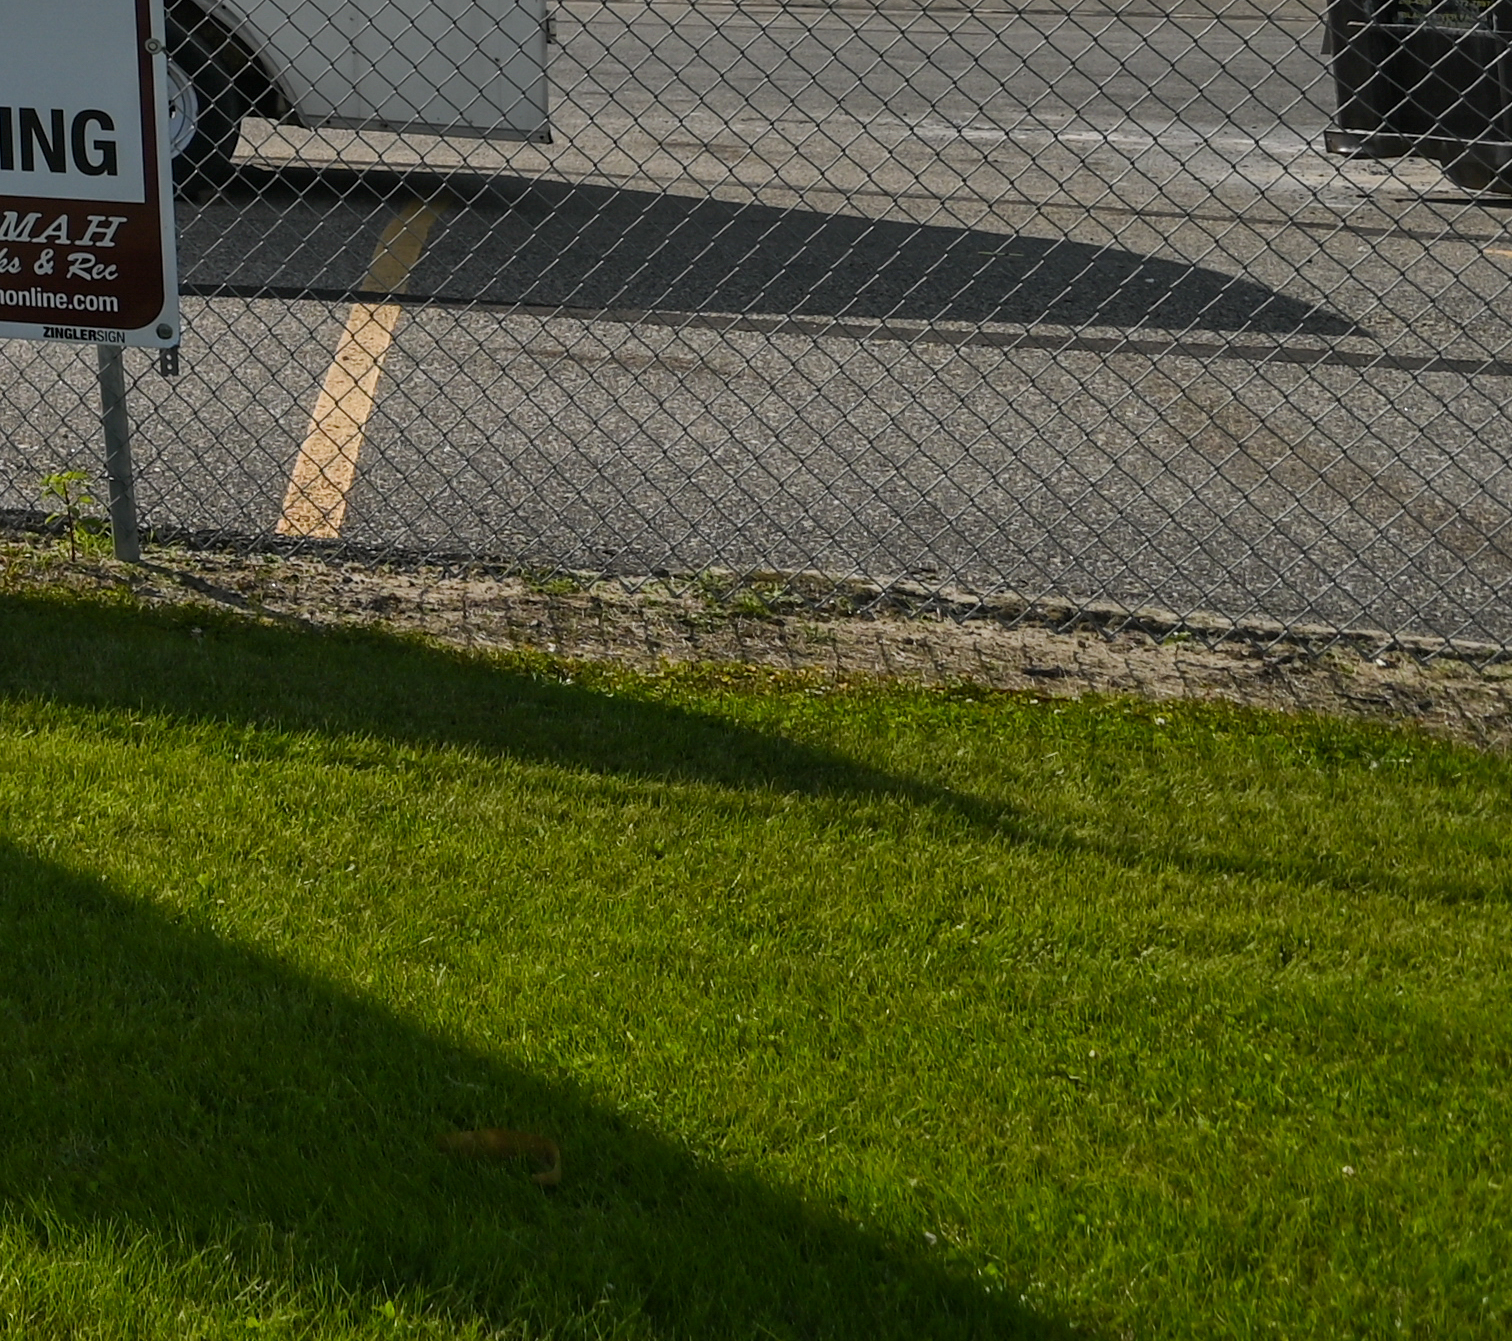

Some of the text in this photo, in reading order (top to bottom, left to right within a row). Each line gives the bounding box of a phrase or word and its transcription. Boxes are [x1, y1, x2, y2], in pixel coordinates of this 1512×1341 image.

[33, 248, 55, 276] &
[66, 252, 119, 281] Rec
[42, 326, 126, 344] ZINGLERSIGN
